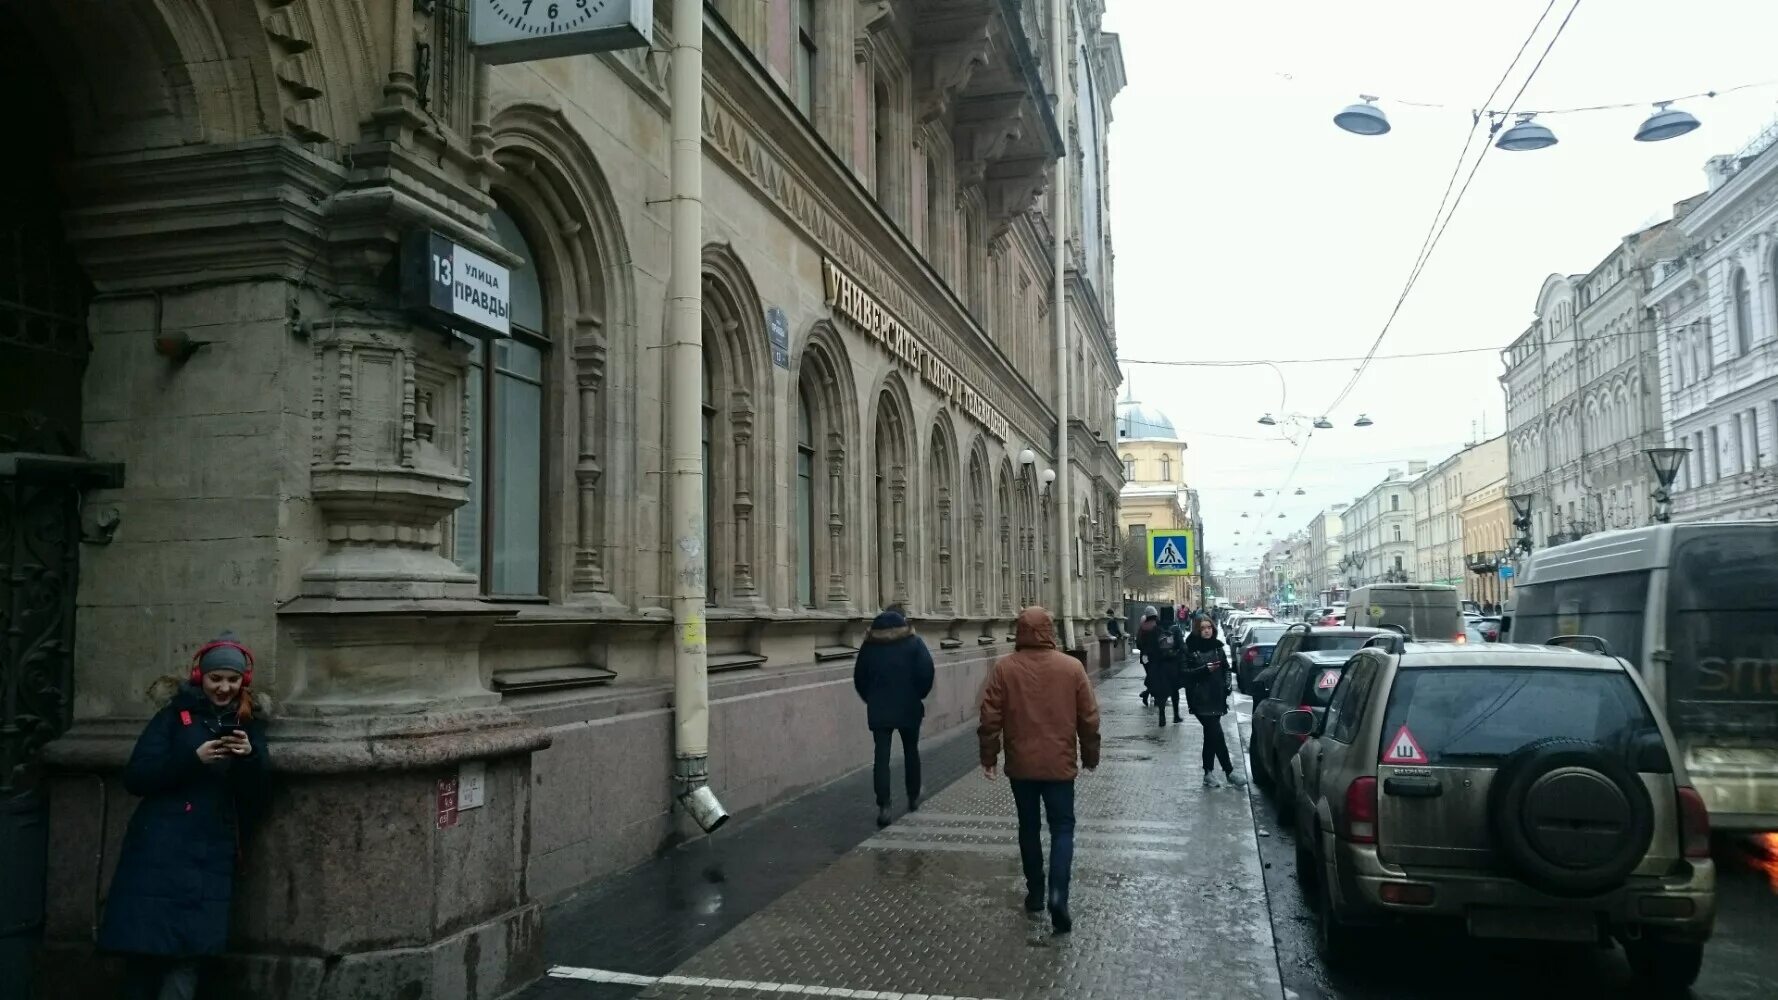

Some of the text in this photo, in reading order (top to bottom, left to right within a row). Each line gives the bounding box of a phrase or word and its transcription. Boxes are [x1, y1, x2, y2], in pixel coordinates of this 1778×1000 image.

[547, 3, 559, 19] 6
[433, 254, 452, 286] 13
[465, 263, 499, 289] УЛИЦА
[454, 280, 509, 319] ПРАВДЫ
[824, 257, 927, 373] УНИВЕРСИТЕТ
[922, 351, 954, 397] КИНО
[1397, 745, 1413, 757] Ш
